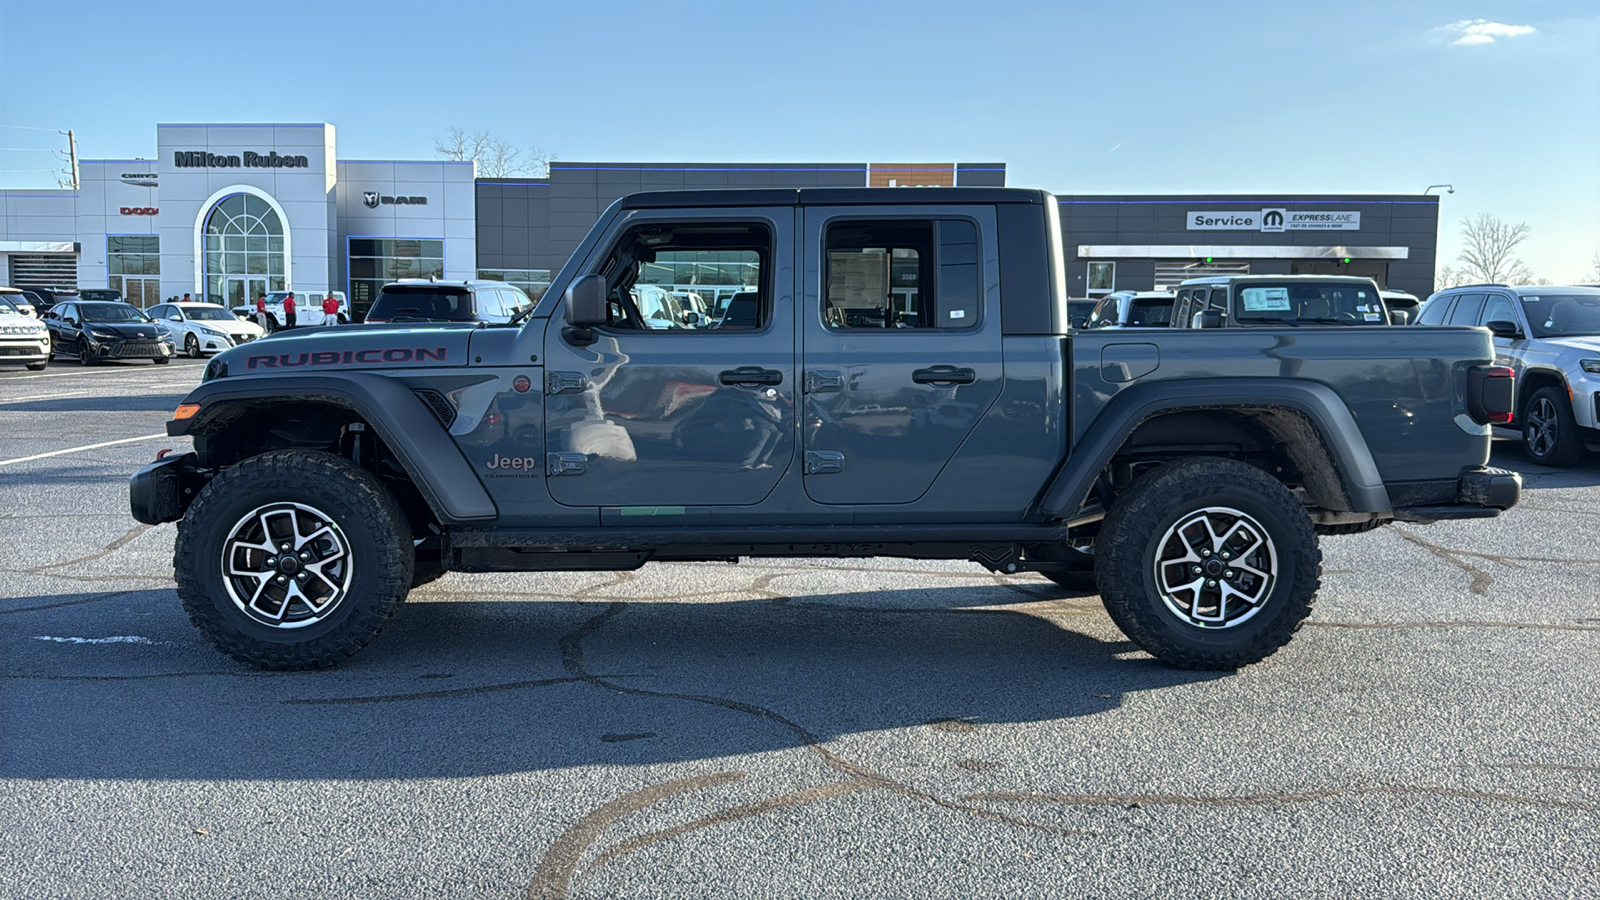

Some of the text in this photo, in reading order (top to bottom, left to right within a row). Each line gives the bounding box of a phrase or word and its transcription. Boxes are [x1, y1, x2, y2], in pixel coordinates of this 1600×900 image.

[174, 151, 308, 168] Milton Ruben
[381, 196, 427, 205] RAM
[1195, 215, 1253, 226] Service
[246, 347, 447, 369] RUBICON
[486, 453, 535, 472] Jeep
